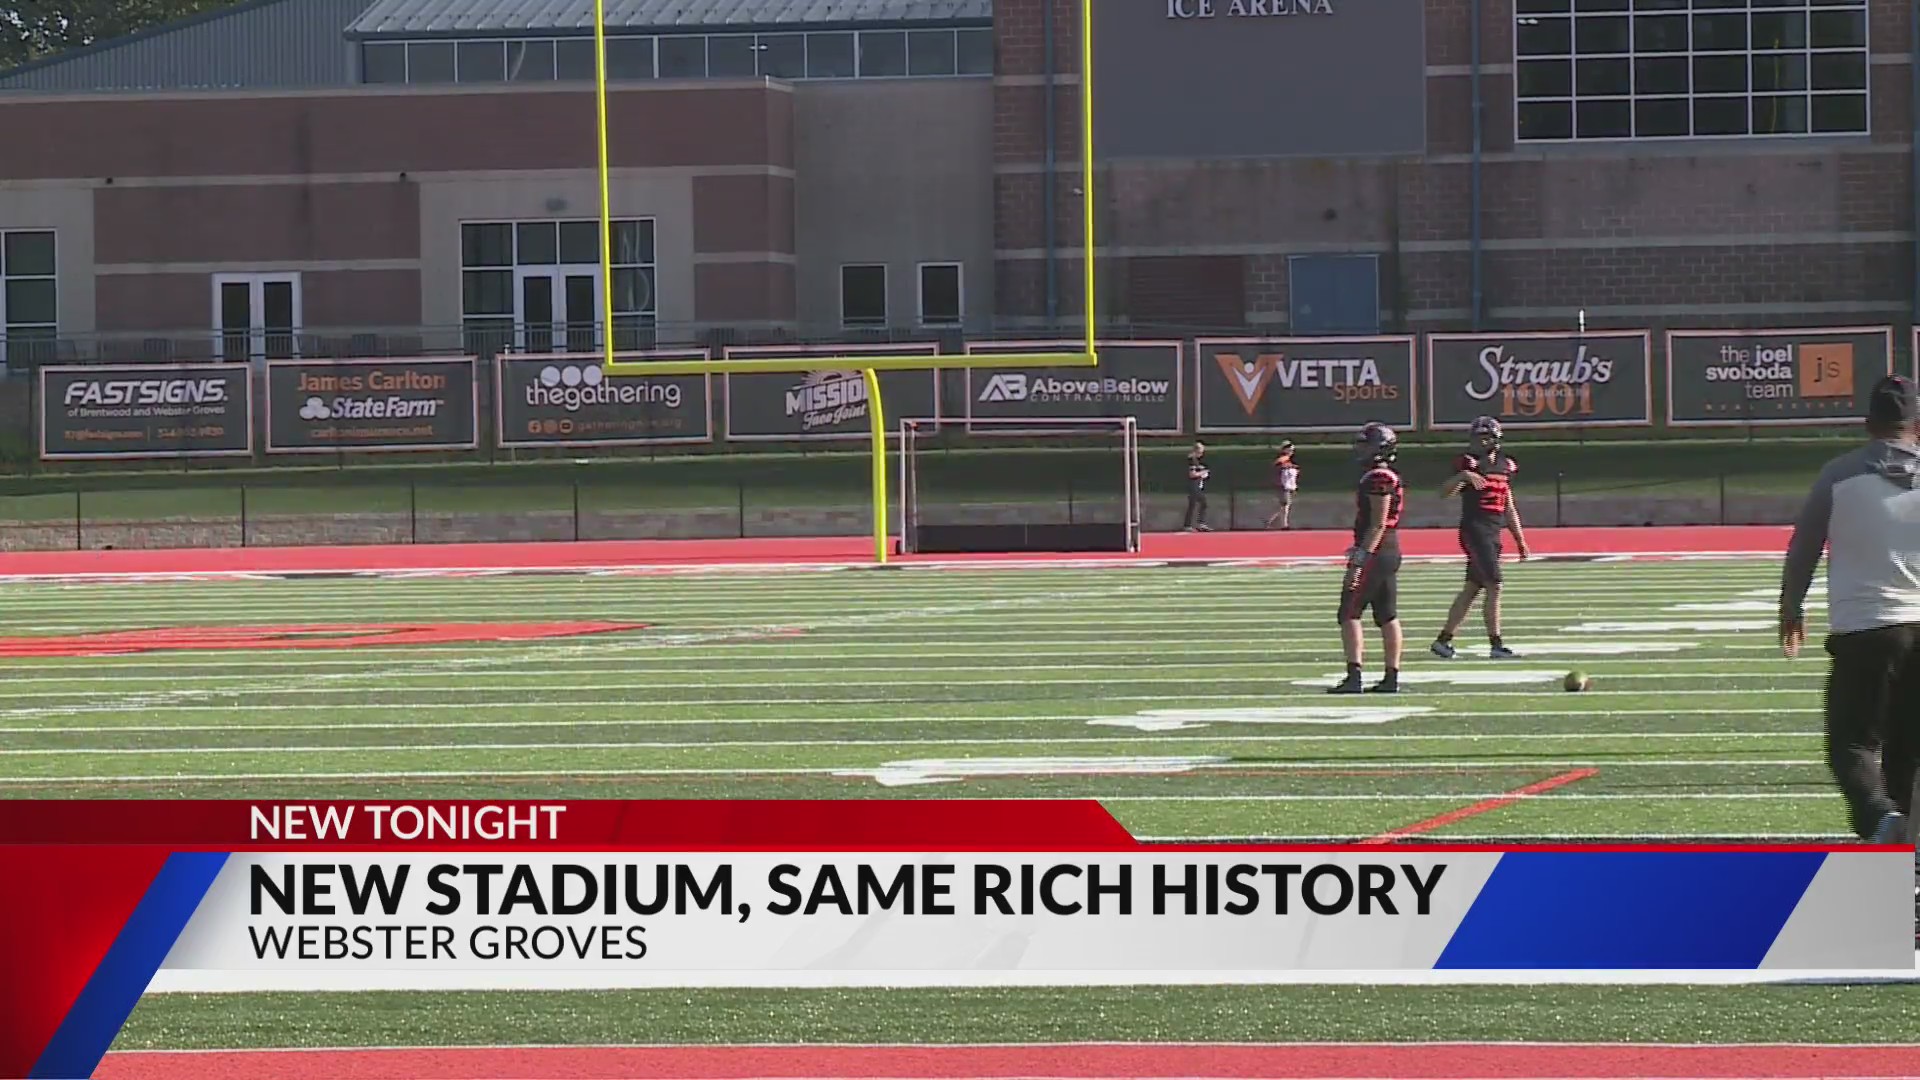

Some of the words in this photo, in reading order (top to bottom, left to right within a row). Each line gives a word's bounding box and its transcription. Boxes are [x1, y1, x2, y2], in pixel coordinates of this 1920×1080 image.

[1166, 0, 1216, 18] ICE
[1226, 0, 1334, 17] ARENA
[1720, 345, 1750, 364] the
[1754, 344, 1793, 367] joel
[297, 373, 363, 392] James
[368, 371, 446, 390] Carlton
[1275, 359, 1382, 388] VETTA
[1464, 345, 1613, 400] Straub's
[1705, 364, 1793, 381] svoboda
[526, 376, 682, 411] thegathering
[1333, 382, 1399, 405] Sports
[1500, 382, 1595, 416] 1901
[1745, 382, 1794, 399] team
[67, 408, 78, 418] of
[80, 407, 132, 418] Brentwood
[133, 406, 152, 417] and
[153, 406, 192, 417] Webster
[192, 405, 226, 416] Groves
